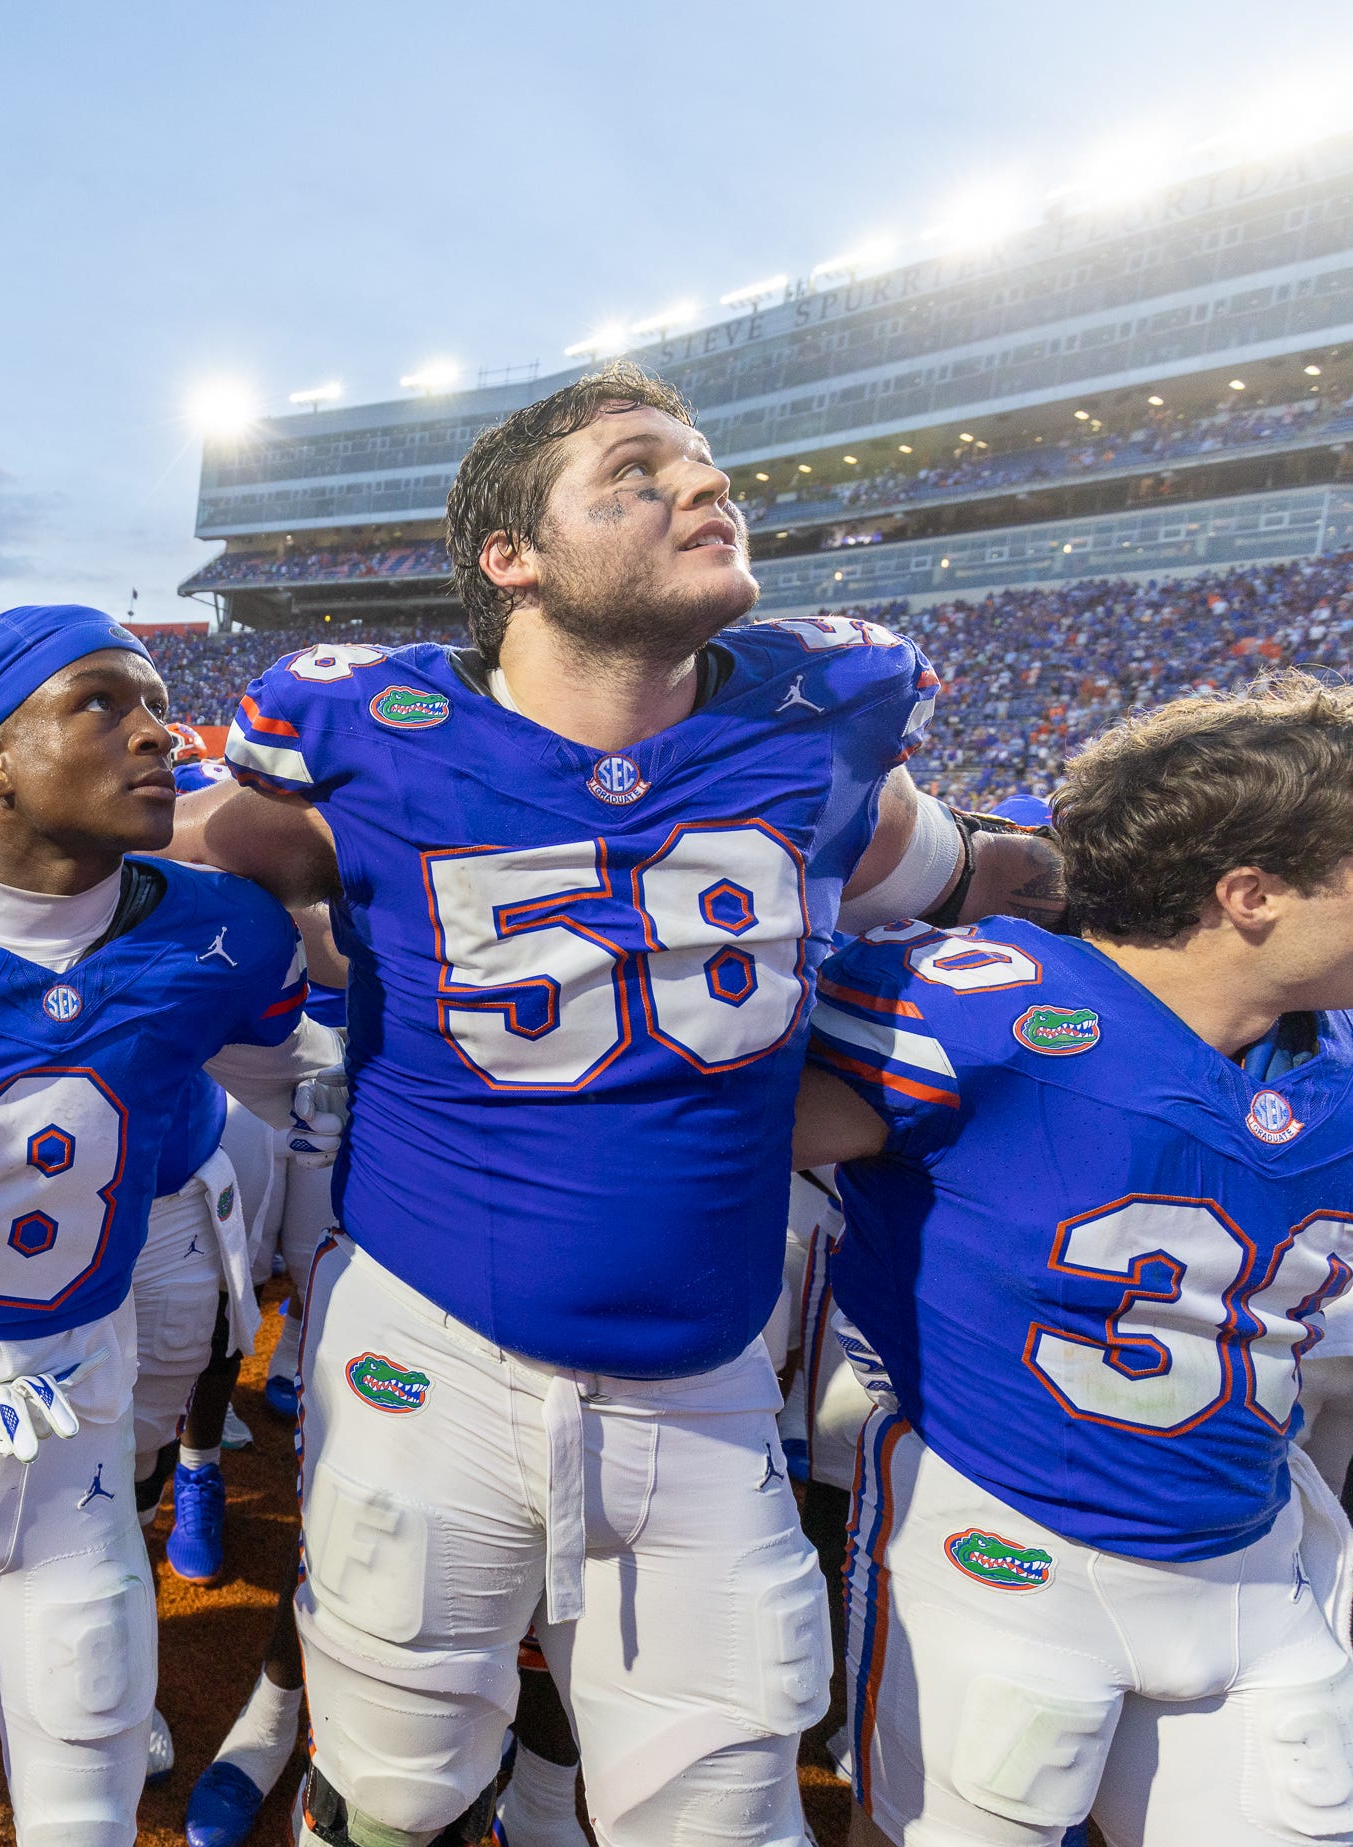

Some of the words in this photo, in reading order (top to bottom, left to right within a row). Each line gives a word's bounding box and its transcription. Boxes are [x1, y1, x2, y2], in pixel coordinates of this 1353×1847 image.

[598, 757, 635, 792] SEC
[595, 787, 641, 804] GRADUATE
[420, 817, 811, 1092] 58
[47, 988, 78, 1019] SEC
[1254, 1093, 1288, 1131] SEC
[1253, 1124, 1294, 1142] GRADUATE
